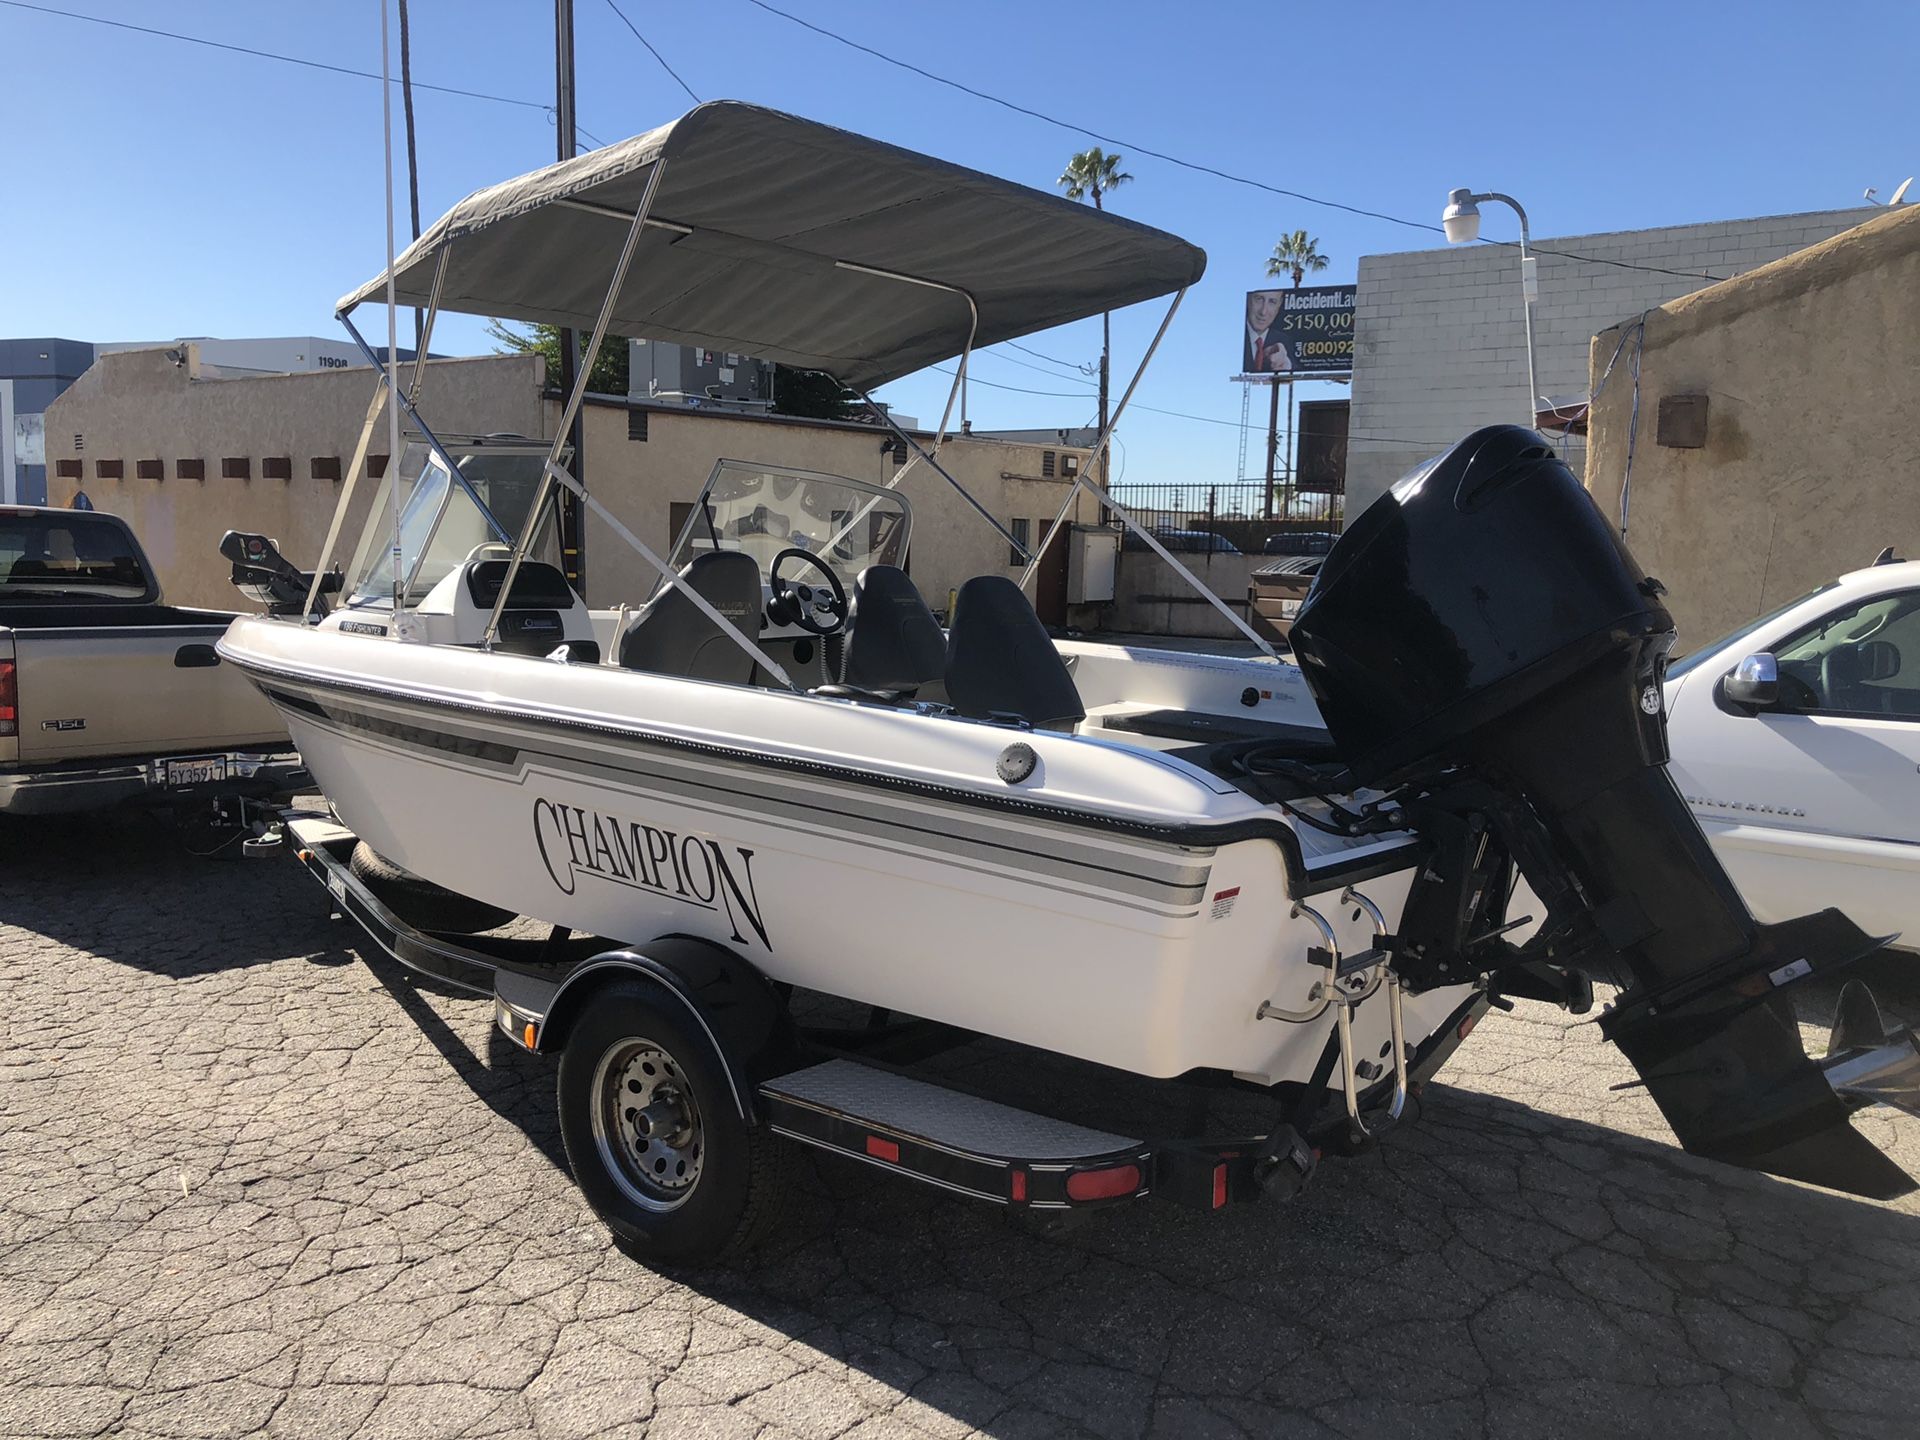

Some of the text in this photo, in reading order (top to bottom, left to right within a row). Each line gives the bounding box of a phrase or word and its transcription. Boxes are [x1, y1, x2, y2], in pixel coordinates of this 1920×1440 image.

[1283, 312, 1355, 331] $150,00
[170, 766, 223, 784] 5Y35917
[533, 797, 773, 953] CHAMPION
